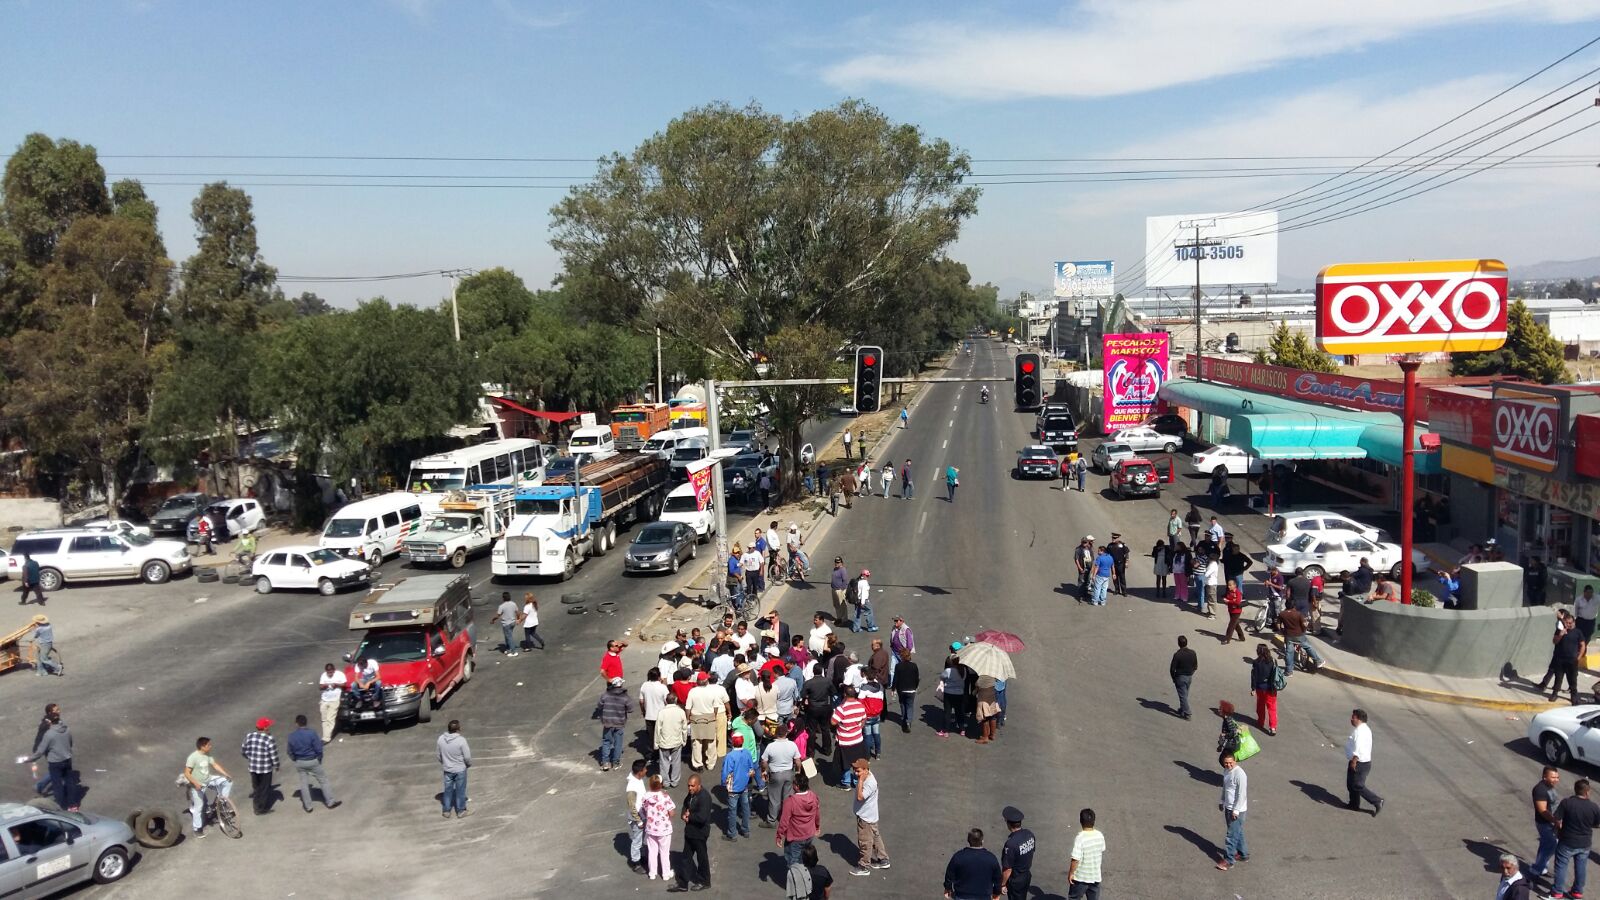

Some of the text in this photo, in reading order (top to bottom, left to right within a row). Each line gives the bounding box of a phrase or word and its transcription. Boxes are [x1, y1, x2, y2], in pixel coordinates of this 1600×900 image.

[1330, 279, 1501, 336] OXXO
[1106, 339, 1157, 347] PESCADOS
[1110, 347, 1161, 355] MARISCOS
[1213, 362, 1243, 382] PESCADOS
[1250, 368, 1287, 390] MARISCOS
[1295, 373, 1352, 400] Costa
[1495, 405, 1554, 453] OXXO
